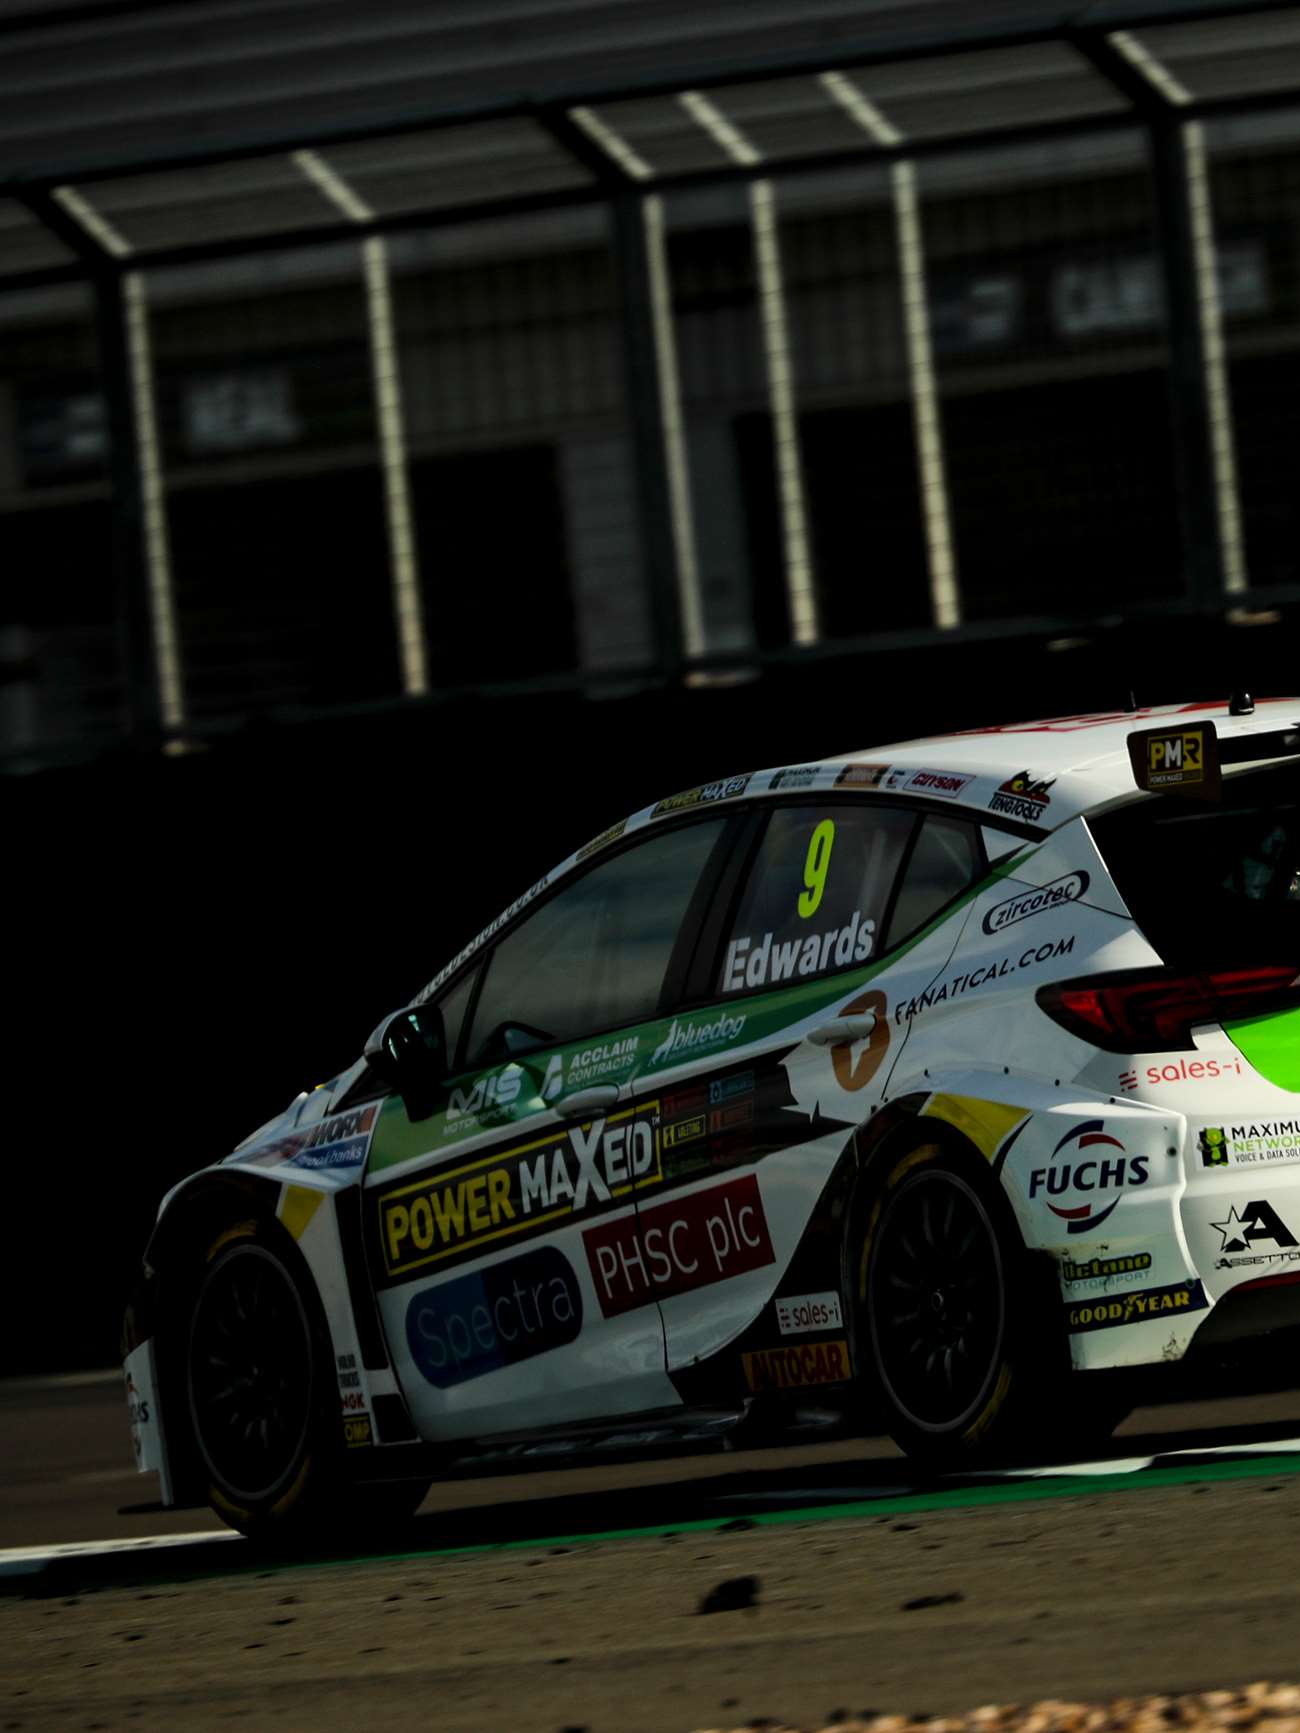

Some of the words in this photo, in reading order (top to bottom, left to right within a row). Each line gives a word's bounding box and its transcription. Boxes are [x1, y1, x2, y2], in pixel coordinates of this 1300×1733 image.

[912, 773, 965, 791] GUYSON
[798, 818, 837, 919] 9
[995, 882, 1075, 926] zircotec
[721, 911, 876, 994] Edwards
[896, 936, 1076, 1025] FANATICAL.COM
[671, 1013, 748, 1049] bluedog
[567, 1053, 637, 1084] CONTRACTS
[570, 1036, 640, 1070] ACCLAIM
[1146, 1057, 1242, 1085] sales-i
[1235, 1151, 1257, 1163] VOICE
[1267, 1149, 1284, 1160] DATA
[386, 1168, 517, 1261] POWER
[519, 1116, 656, 1214] MAXED
[1029, 1155, 1149, 1199] FUCHS
[595, 1219, 699, 1301] PHSC
[706, 1197, 762, 1273] plc
[1216, 1251, 1300, 1270] ASSETTO
[416, 1275, 576, 1372] Spectra
[792, 1301, 839, 1327] sales-i
